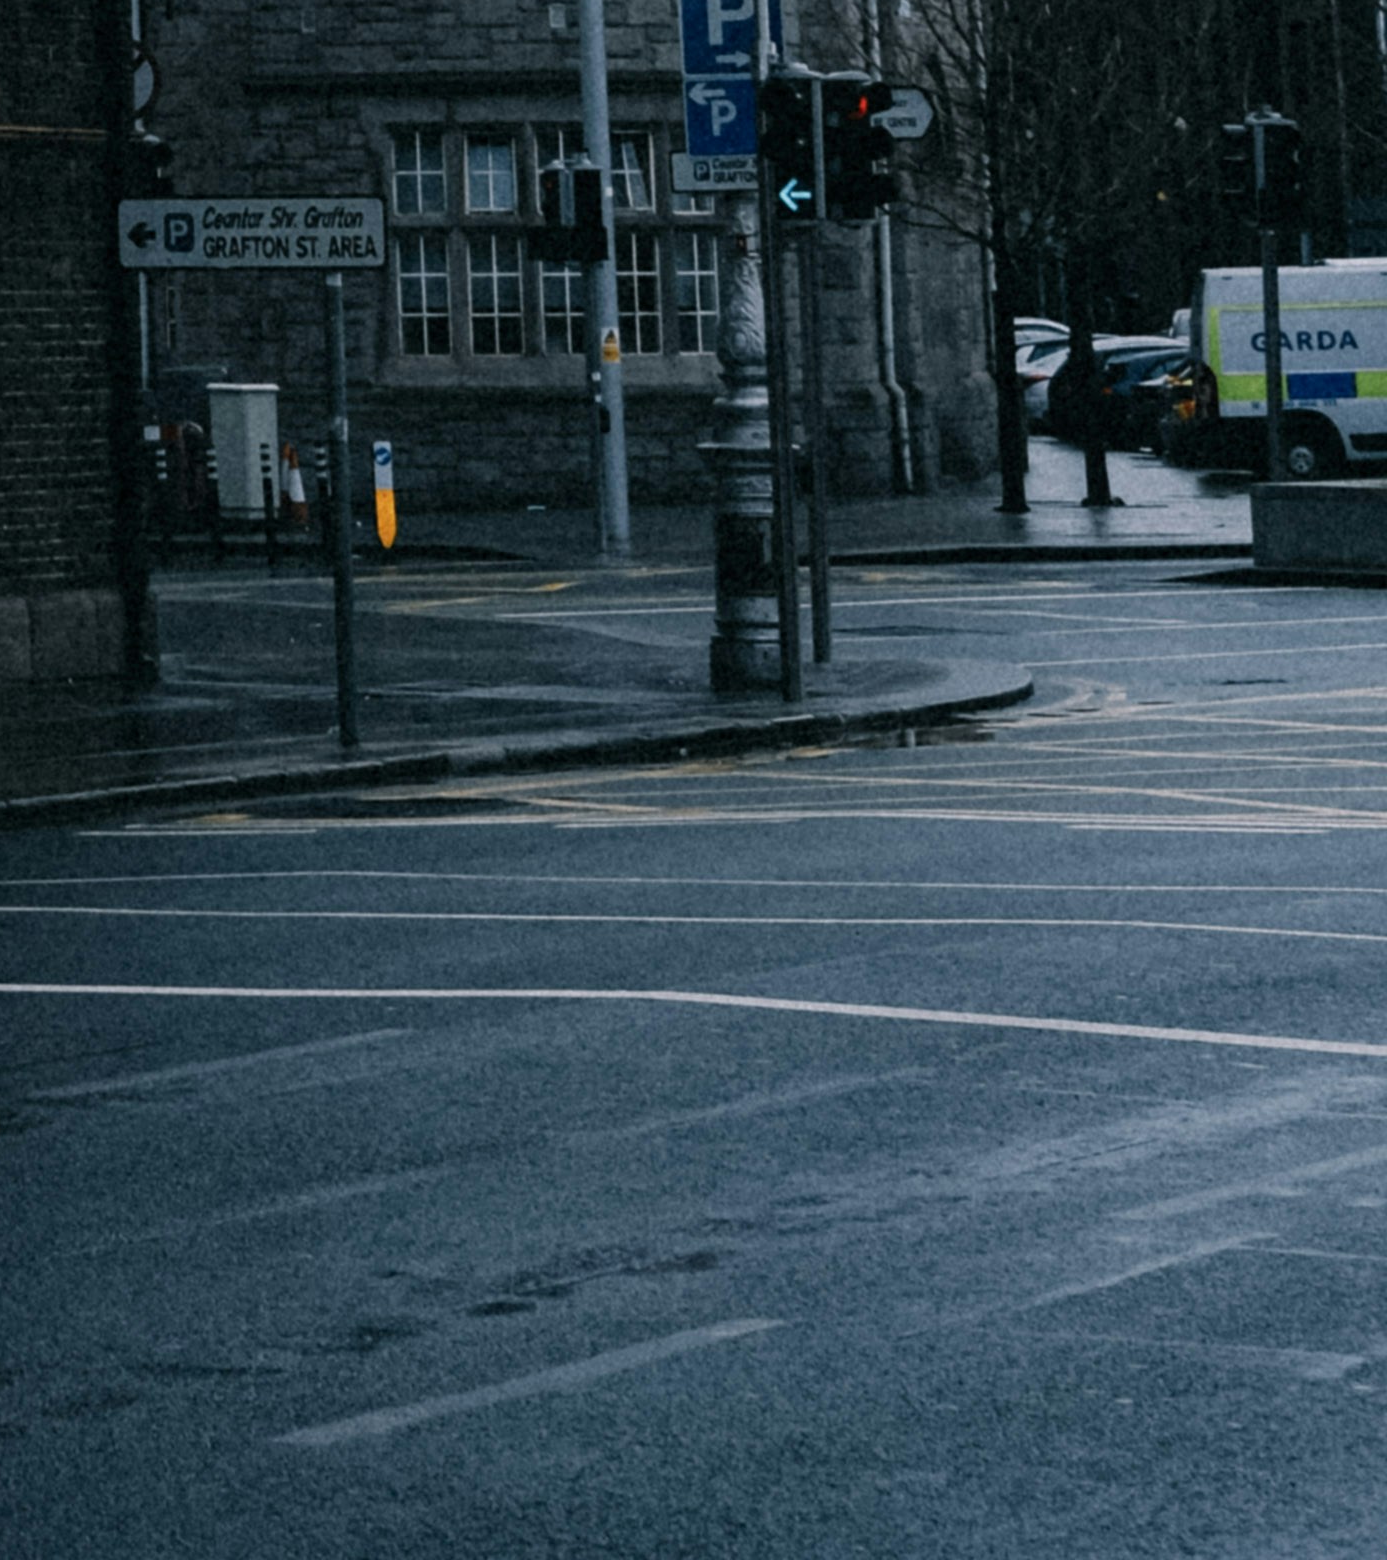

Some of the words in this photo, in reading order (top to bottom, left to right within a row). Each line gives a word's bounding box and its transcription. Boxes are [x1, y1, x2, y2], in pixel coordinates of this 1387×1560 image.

[710, 99, 737, 137] P
[202, 206, 264, 229] Ceantar
[269, 206, 297, 229] Shr.
[304, 206, 363, 229] Grafton
[203, 235, 289, 258] GRAFTON
[296, 236, 321, 258] ST.
[328, 236, 377, 258] AREA
[1251, 330, 1359, 352] GARDA
